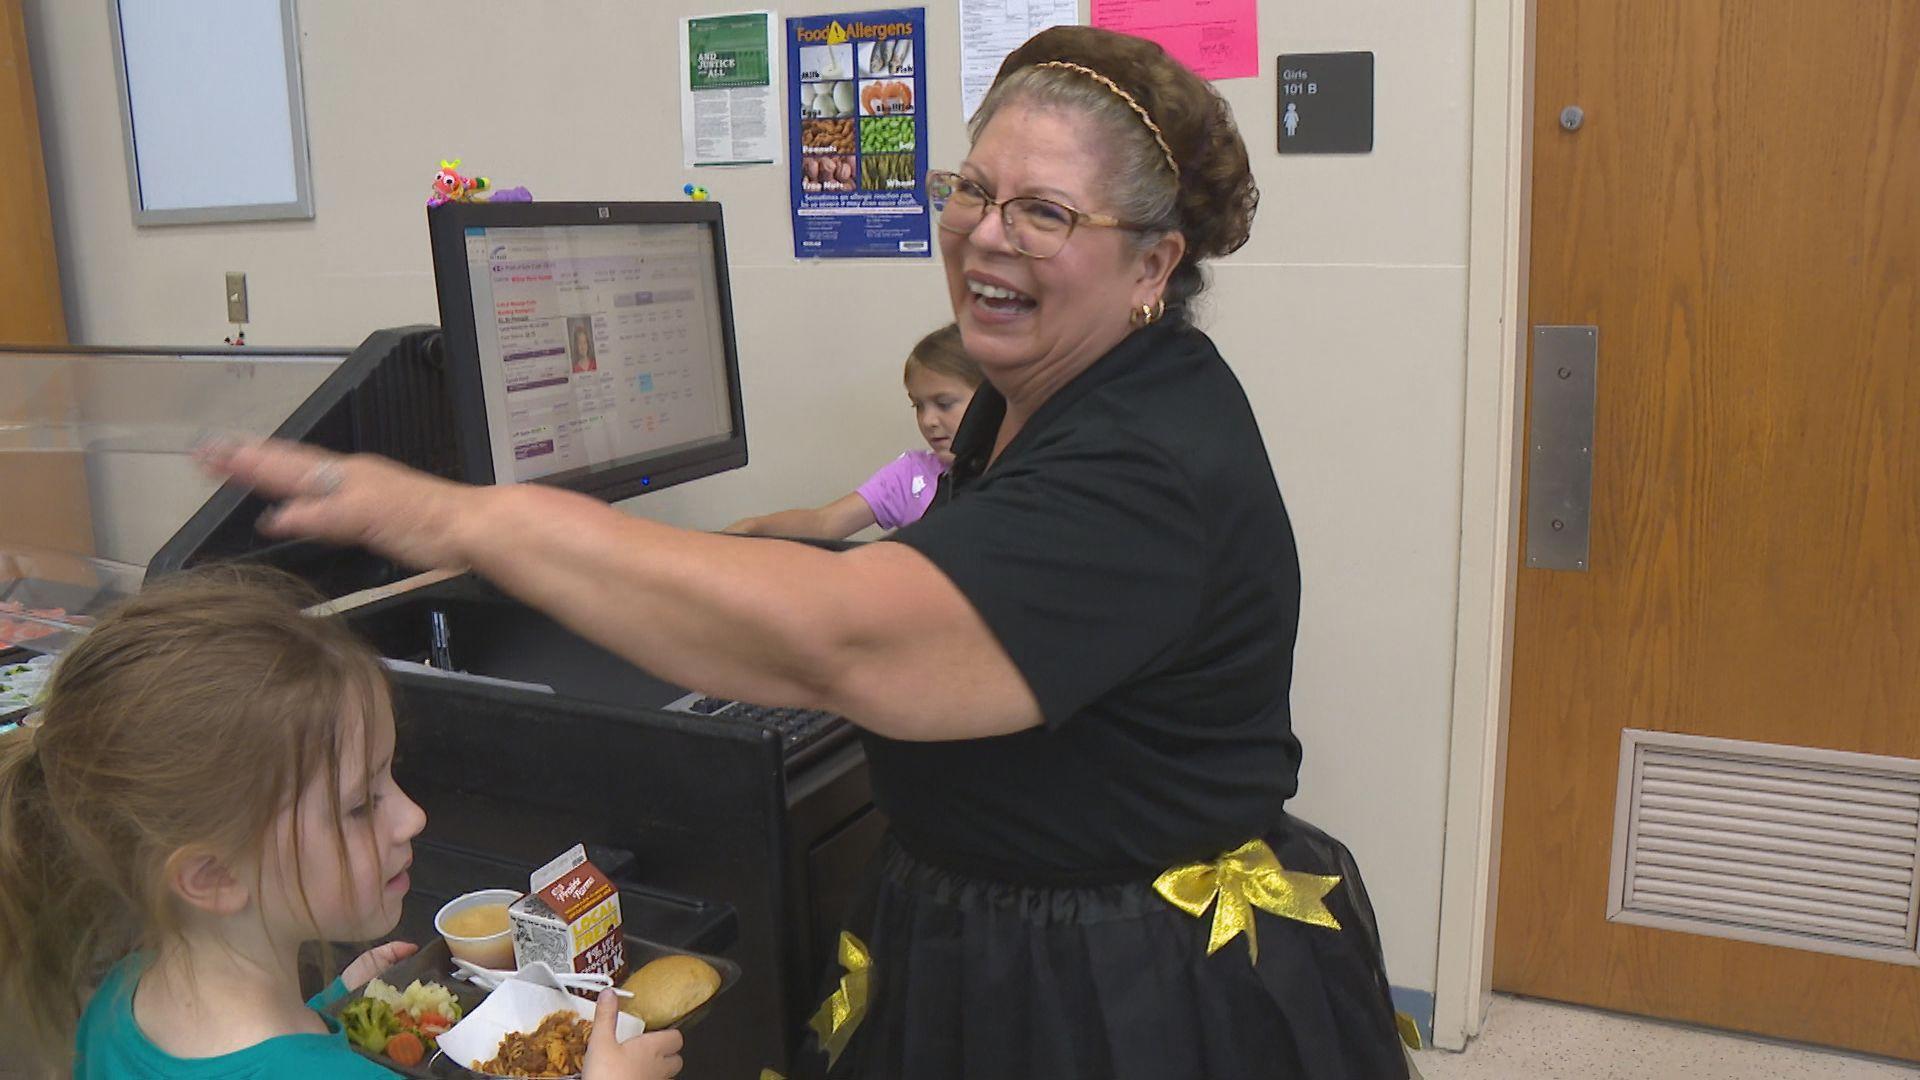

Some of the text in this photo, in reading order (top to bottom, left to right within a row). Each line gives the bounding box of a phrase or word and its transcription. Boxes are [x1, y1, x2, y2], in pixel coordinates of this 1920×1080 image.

[796, 22, 913, 41] Food Allergens
[698, 51, 717, 61] AND
[698, 59, 735, 70] JUSTICE
[708, 69, 726, 78] ALL
[802, 71, 820, 79] Milk
[896, 66, 913, 74] Fish
[1283, 69, 1308, 80] Girls
[1283, 83, 1317, 95] 101 B
[802, 109, 821, 117] Eggs
[876, 104, 914, 113] Shellfish
[803, 145, 837, 154] Peanuts
[802, 180, 844, 190] Tree Nuts
[887, 179, 915, 189] Wheat
